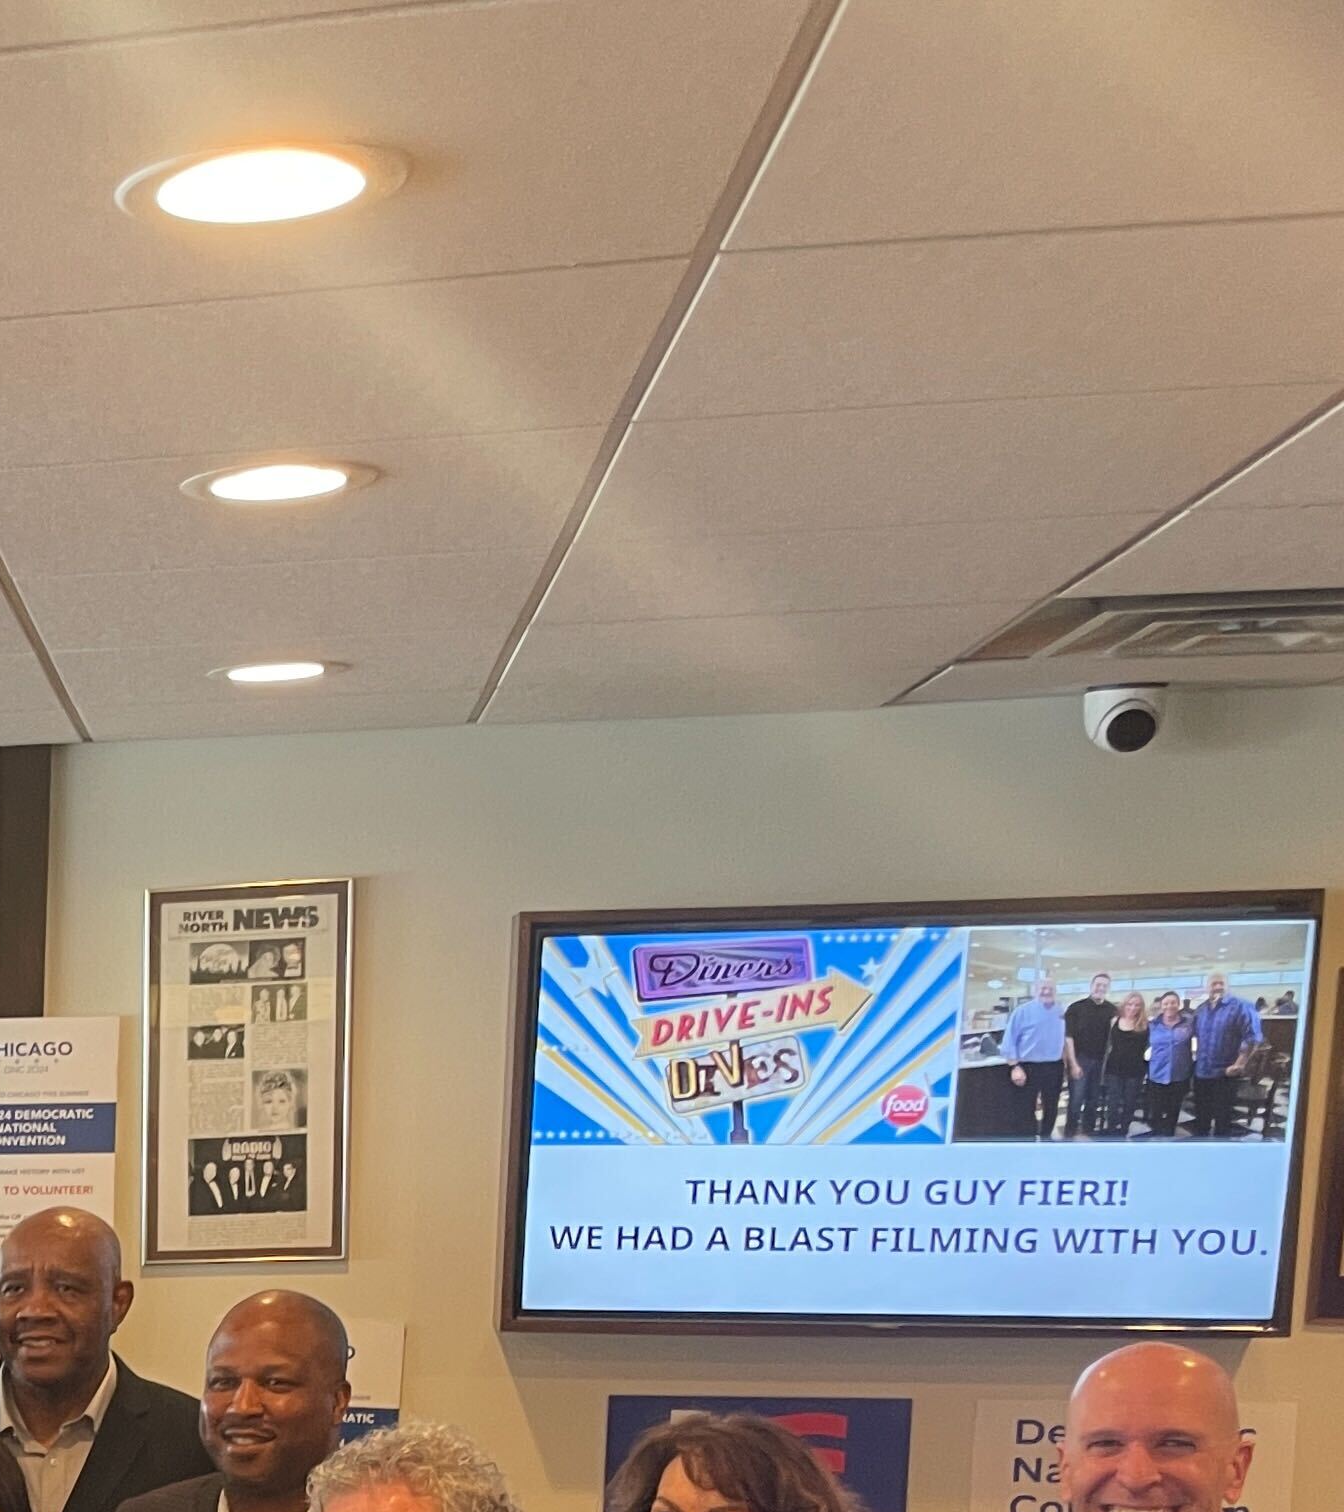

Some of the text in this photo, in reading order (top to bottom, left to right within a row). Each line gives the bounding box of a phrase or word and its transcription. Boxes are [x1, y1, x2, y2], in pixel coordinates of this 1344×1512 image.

[179, 922, 228, 934] NORTH
[183, 911, 224, 922] RIVER
[233, 906, 320, 931] NEWS
[649, 953, 793, 987] Diners
[651, 986, 834, 1047] DRIVE-INS
[14, 1108, 94, 1120] DEMOCRATIC
[883, 1094, 928, 1118] food
[232, 1141, 272, 1154] RADIO
[4, 1186, 20, 1196] TO
[22, 1185, 93, 1196] VOLUNTEER!
[685, 1180, 1129, 1206] THANK YOU GUY FIERI!
[550, 1225, 1268, 1255] WE HAD A BLAST FILMING WITH YOU.
